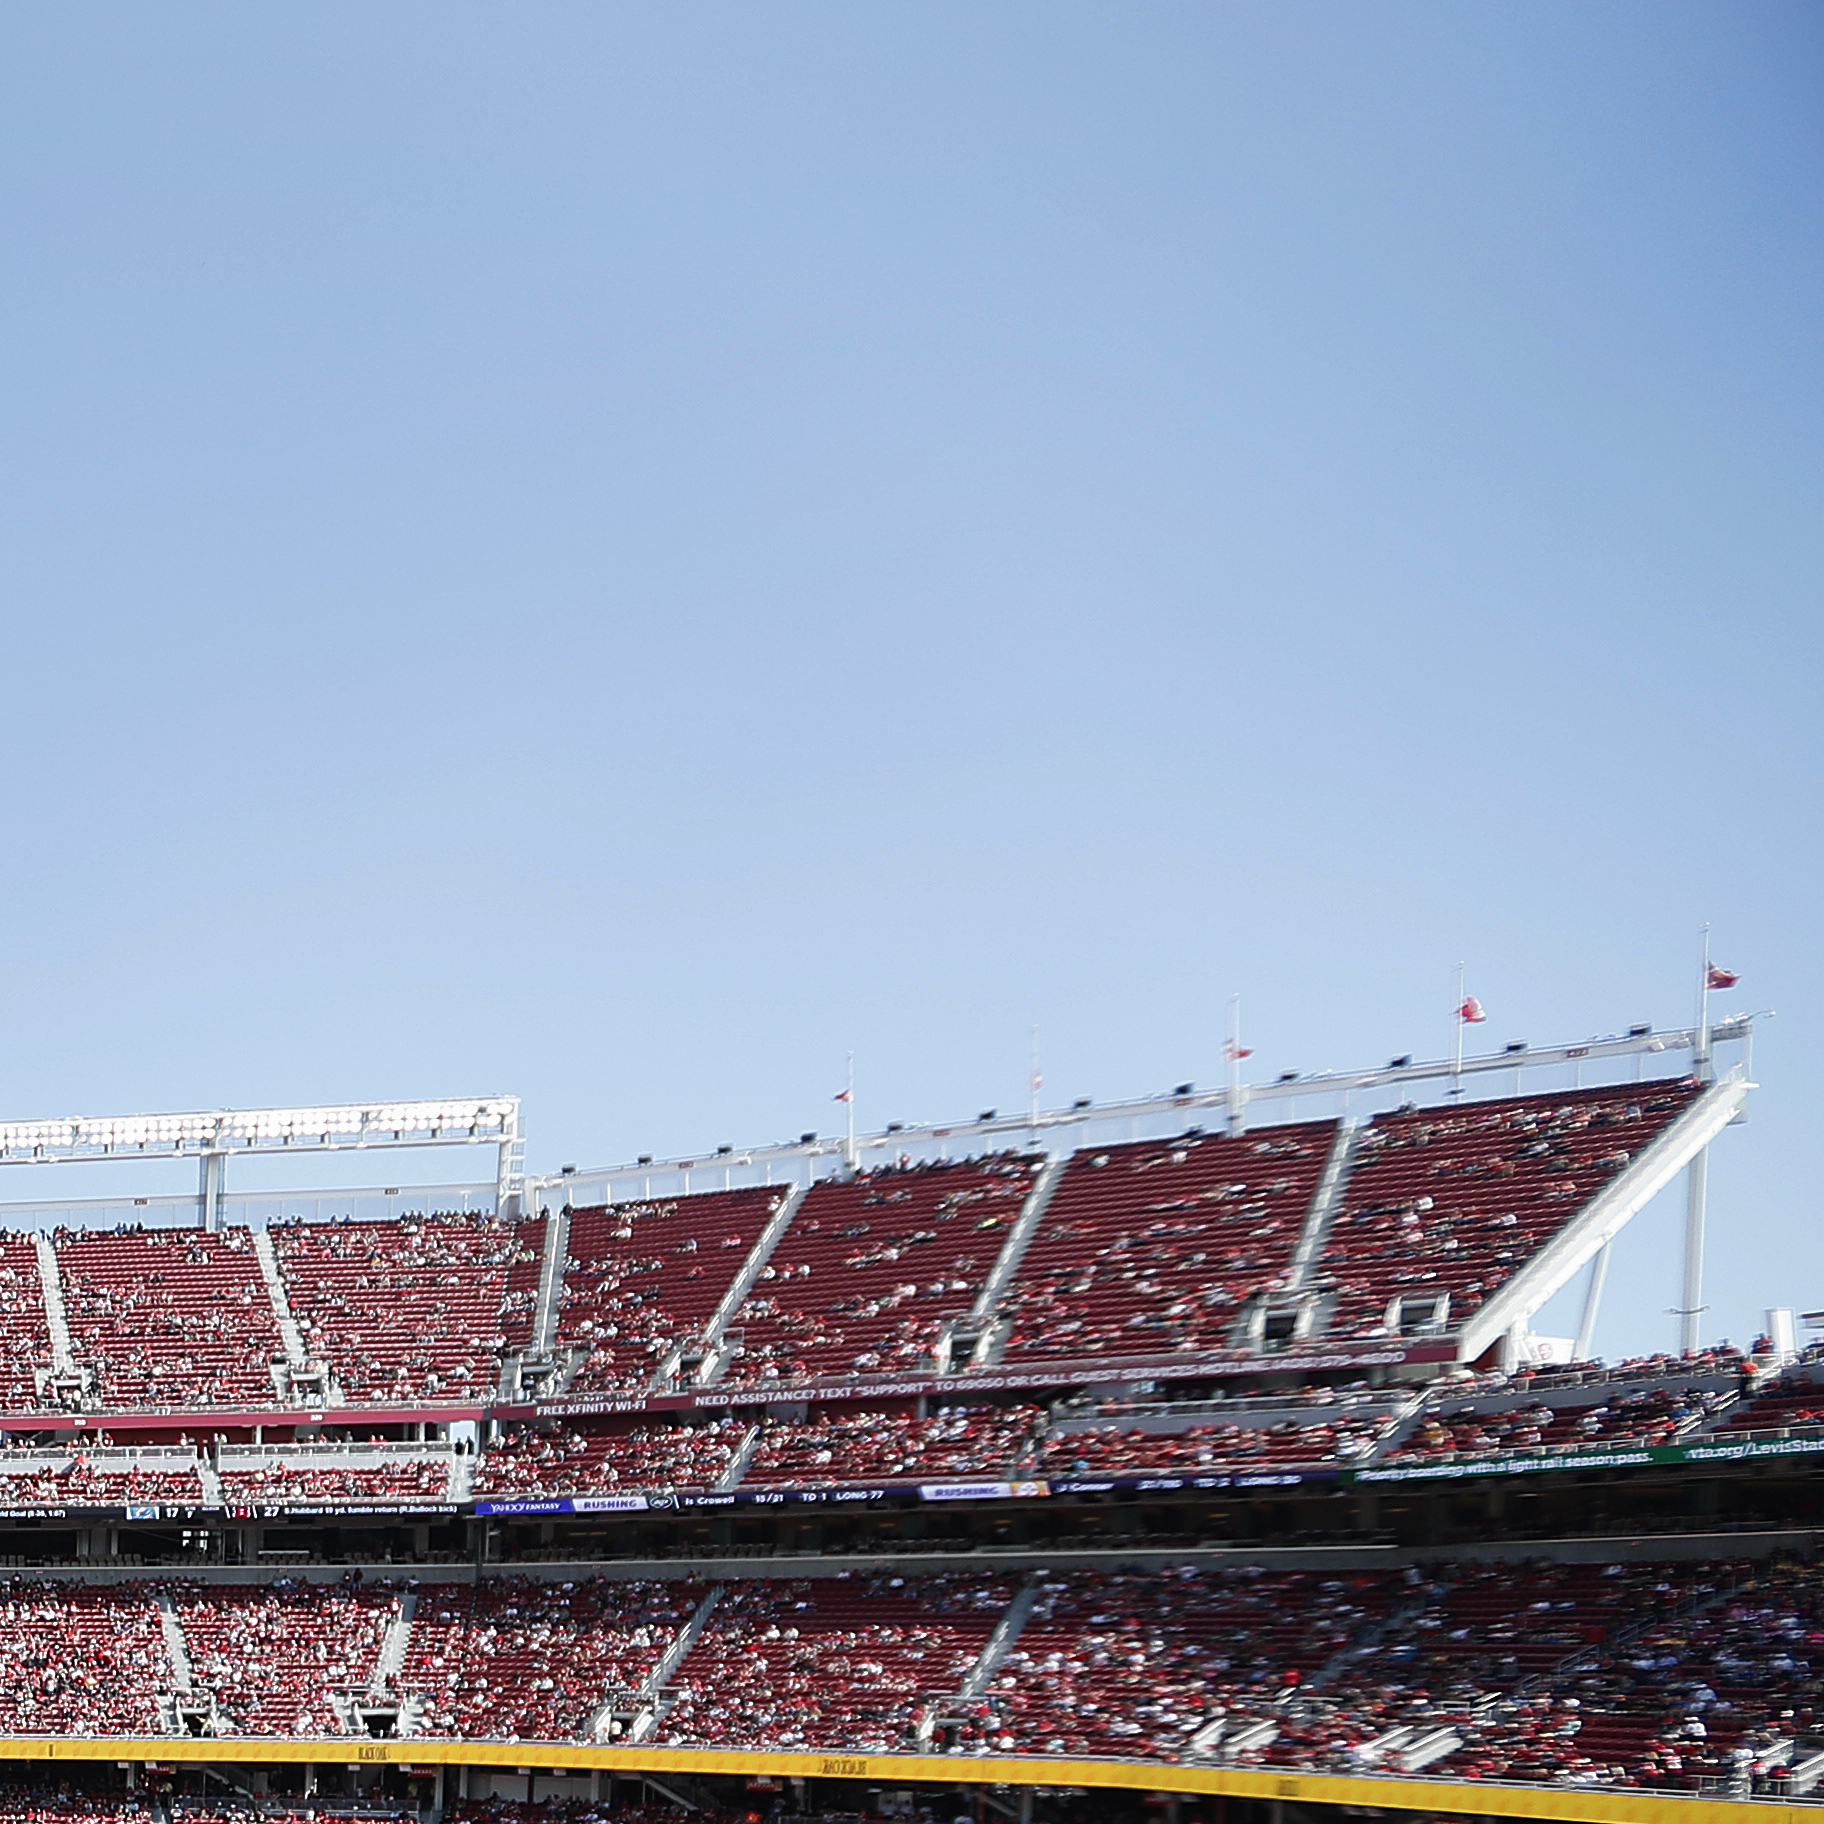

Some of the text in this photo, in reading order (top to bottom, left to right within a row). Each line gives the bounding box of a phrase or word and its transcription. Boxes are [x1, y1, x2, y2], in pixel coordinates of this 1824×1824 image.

[696, 1396, 728, 1406] NEED
[730, 1390, 815, 1405] ASSISTANCE?
[820, 1387, 853, 1398] TEXT
[856, 1382, 932, 1396] "SUPPORT"
[935, 1380, 954, 1390] TO
[956, 1377, 1003, 1389] 69050
[1007, 1376, 1030, 1387] OR
[1031, 1373, 1068, 1386] CALL
[1070, 1370, 1122, 1382] GUEST
[537, 1400, 646, 1415] FREE XFINITY WI-FI
[1467, 1461, 1494, 1473] with
[1496, 1462, 1506, 1471] a
[1509, 1458, 1538, 1474] light
[1540, 1457, 1563, 1468] rail
[1565, 1455, 1609, 1467] season
[1611, 1452, 1653, 1466] pass.
[584, 1499, 637, 1510] RUSHING
[697, 1496, 734, 1505] Crowell
[803, 1493, 817, 1501] TD
[836, 1492, 866, 1500] LONG
[868, 1491, 884, 1499] 77
[166, 1508, 178, 1517] 17
[264, 1507, 347, 1516] 27 yd.
